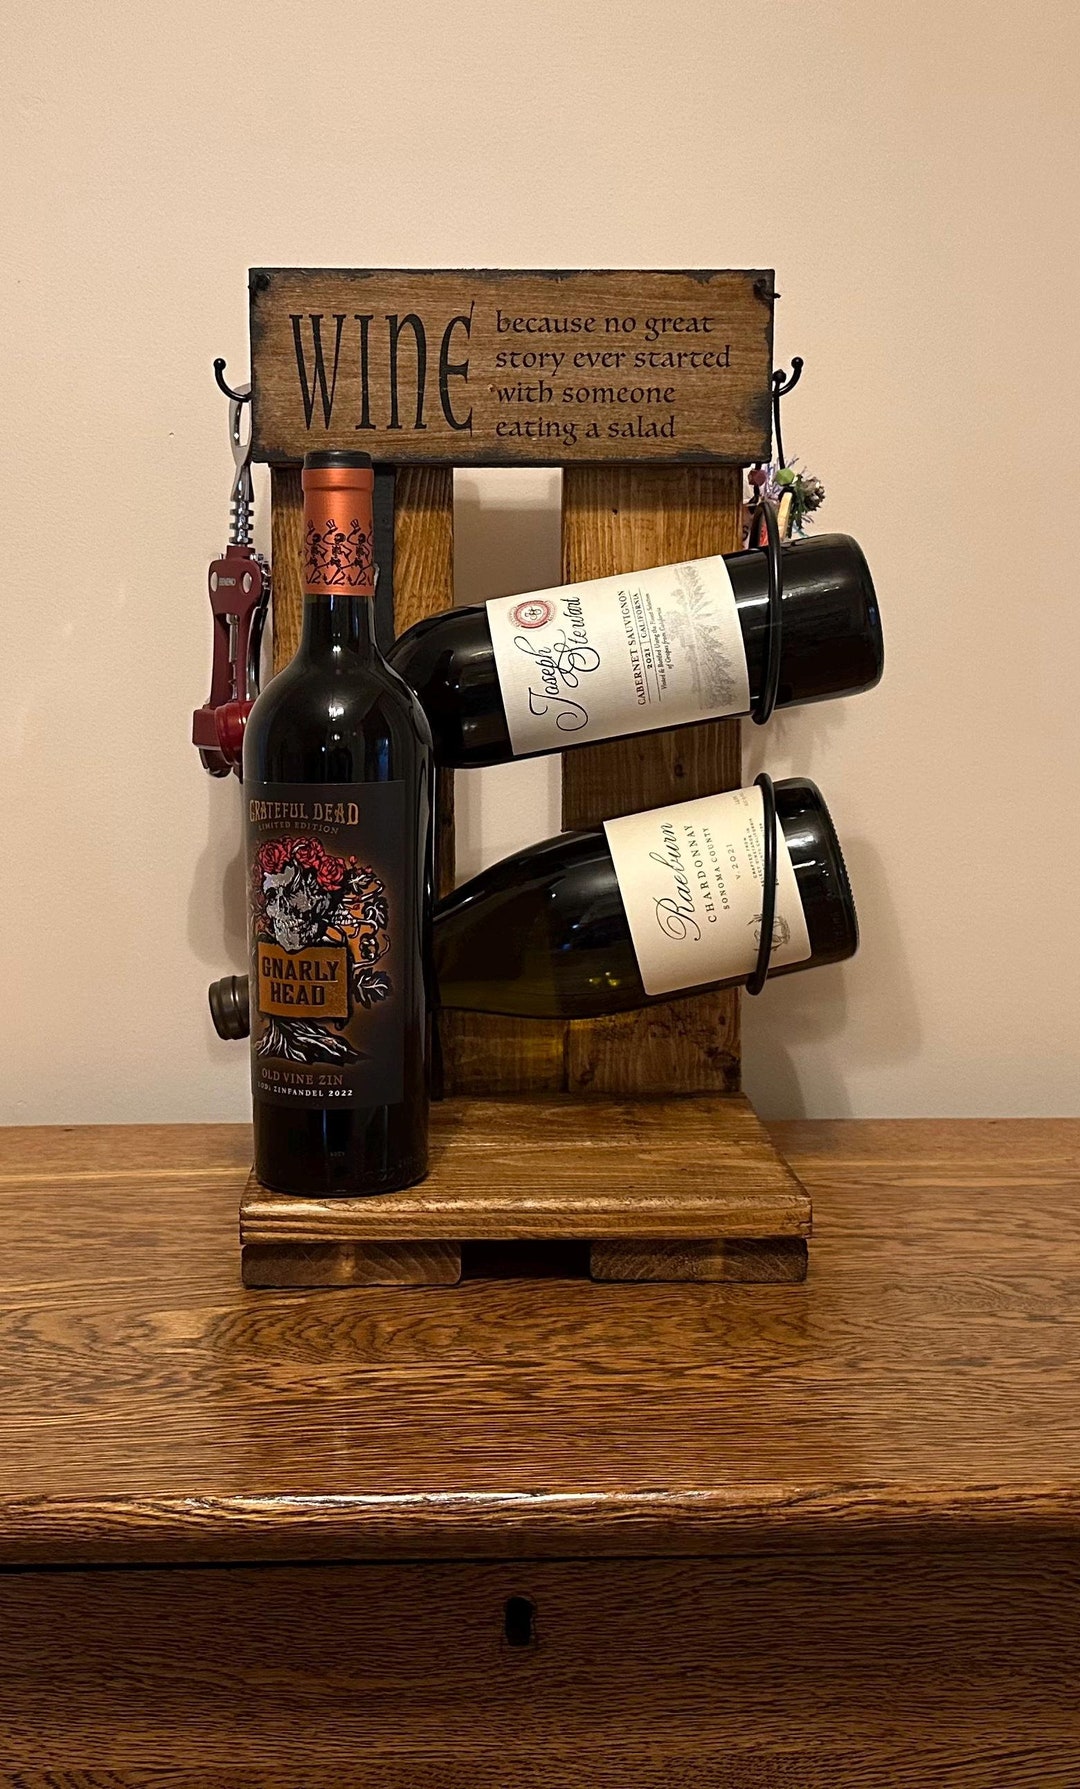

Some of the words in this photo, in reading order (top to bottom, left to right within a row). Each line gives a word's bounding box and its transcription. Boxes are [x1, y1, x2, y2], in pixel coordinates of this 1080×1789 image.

[495, 309, 596, 333] because
[604, 316, 636, 333] no
[645, 314, 714, 341] great
[495, 348, 565, 377] story
[573, 350, 626, 369] ever
[634, 345, 731, 369] started
[496, 381, 553, 404] with
[562, 386, 676, 404] someone
[495, 417, 576, 446] eating
[586, 421, 600, 438] a
[608, 415, 676, 438] salad
[618, 590, 636, 646] SAUVIGNON
[633, 593, 647, 639] CALIFORNIA
[554, 597, 600, 672] Stewart
[644, 648, 653, 670] 2021
[514, 635, 588, 731] Joseph
[629, 649, 646, 705] CABERNET
[250, 800, 308, 822] GRATEFUL
[312, 802, 359, 825] DEAD
[258, 821, 291, 831] LIMITED
[294, 821, 339, 834] EDITION
[702, 827, 718, 863] COUNTY
[726, 843, 739, 869] 2021
[649, 823, 701, 941] Raeburn
[683, 825, 717, 923] CHARDONNAY
[714, 866, 730, 910] SONOMA
[261, 956, 339, 981] GNARLY
[270, 982, 325, 1005] HEAD
[261, 1068, 280, 1081] OLD
[283, 1072, 313, 1085] VINE
[319, 1074, 343, 1085] ZIN
[273, 1086, 324, 1096] ZINFANDEL
